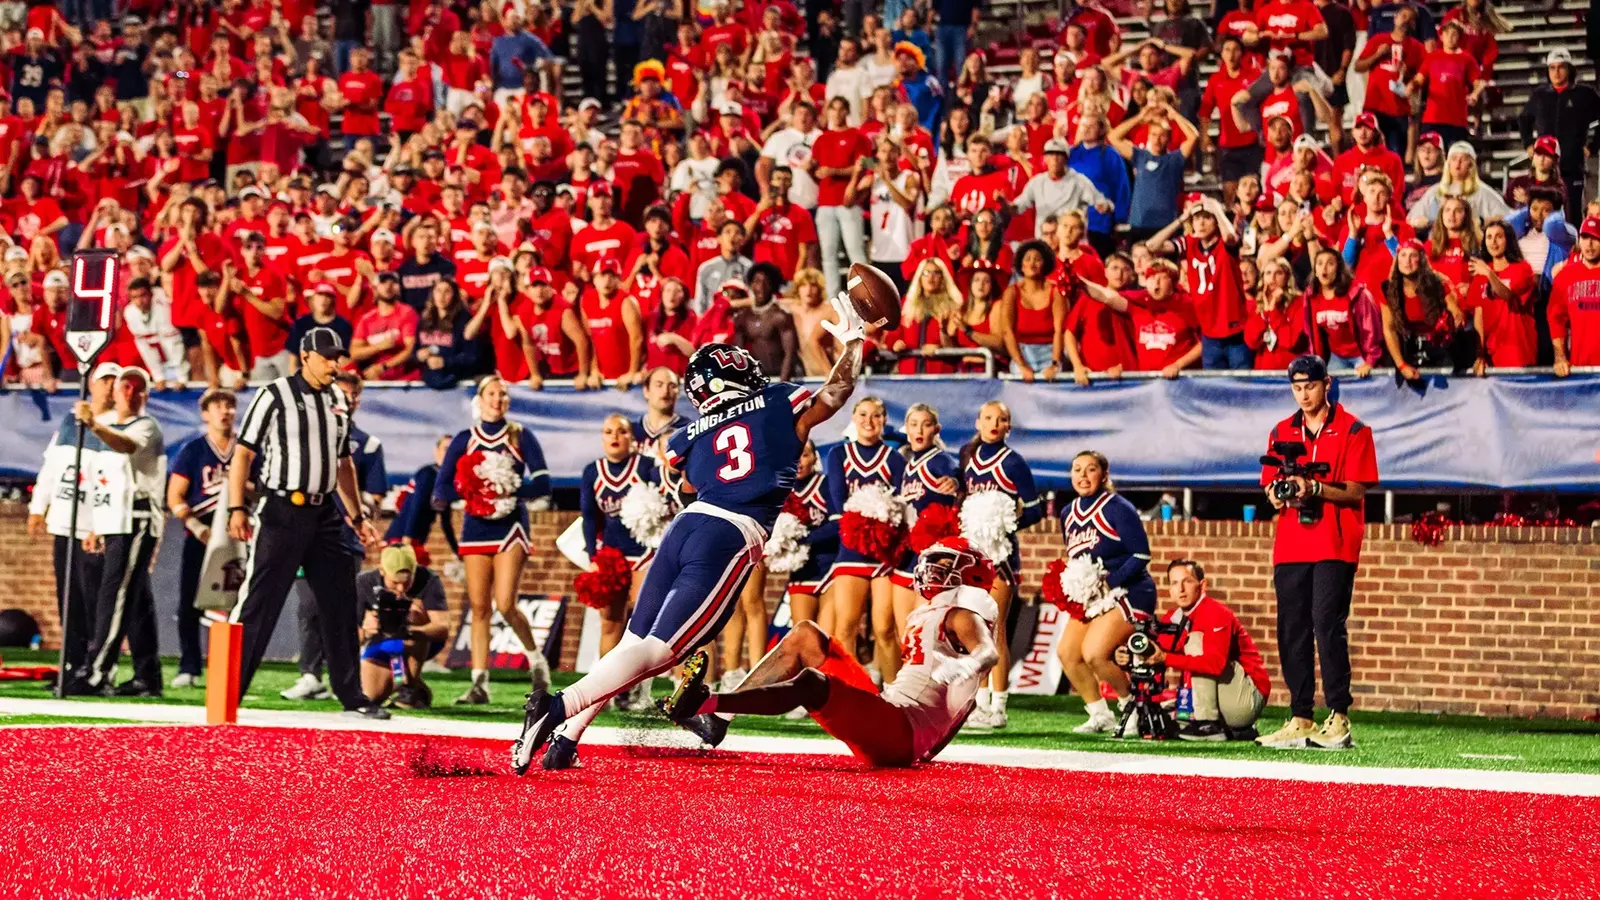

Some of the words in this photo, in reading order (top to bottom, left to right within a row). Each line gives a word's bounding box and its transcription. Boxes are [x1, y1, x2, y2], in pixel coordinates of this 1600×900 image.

[74, 257, 116, 330] 4
[708, 348, 749, 372] LU
[686, 394, 767, 442] SINGLETON
[713, 420, 756, 484] 3
[1016, 610, 1060, 689] WHITE
